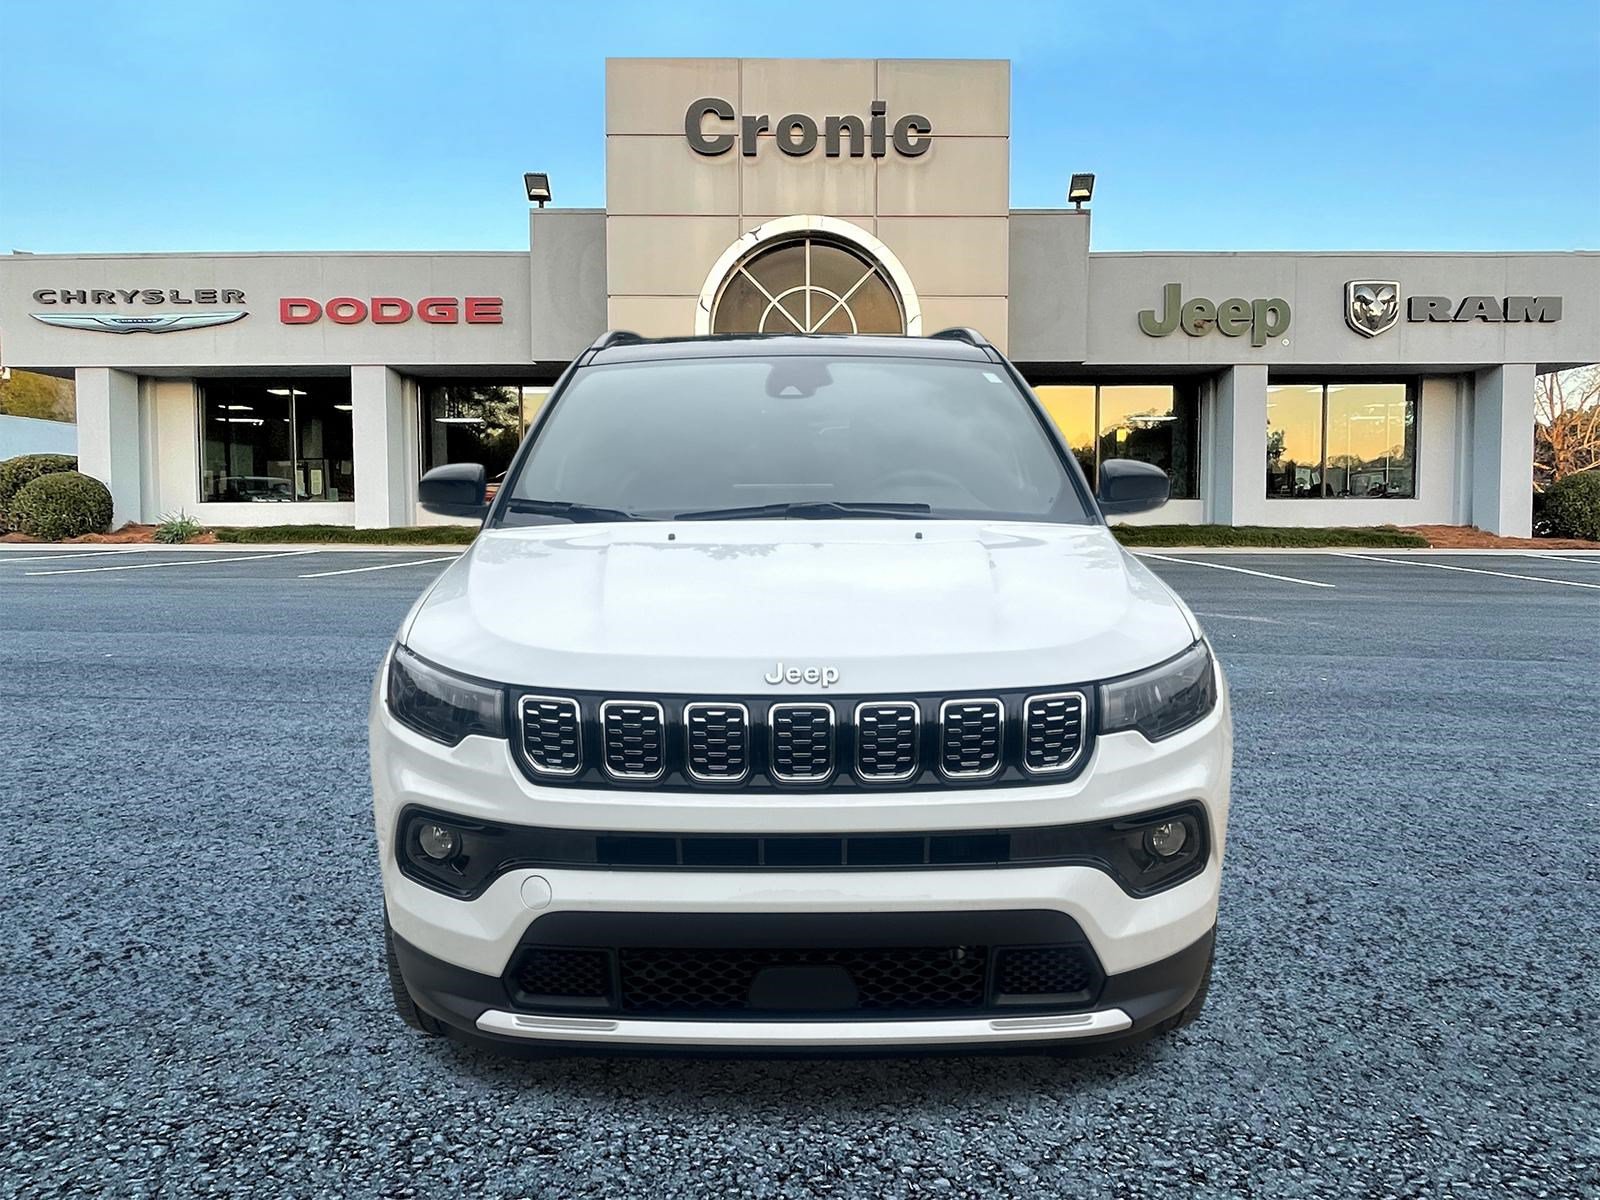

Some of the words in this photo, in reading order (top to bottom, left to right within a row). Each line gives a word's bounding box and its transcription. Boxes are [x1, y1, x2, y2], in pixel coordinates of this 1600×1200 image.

[685, 97, 932, 157] Cronic
[32, 289, 246, 305] CHRYSLER
[1407, 296, 1563, 322] RAM
[279, 297, 503, 324] DODGE
[1138, 283, 1292, 347] Jeep
[764, 662, 840, 688] Jeep
